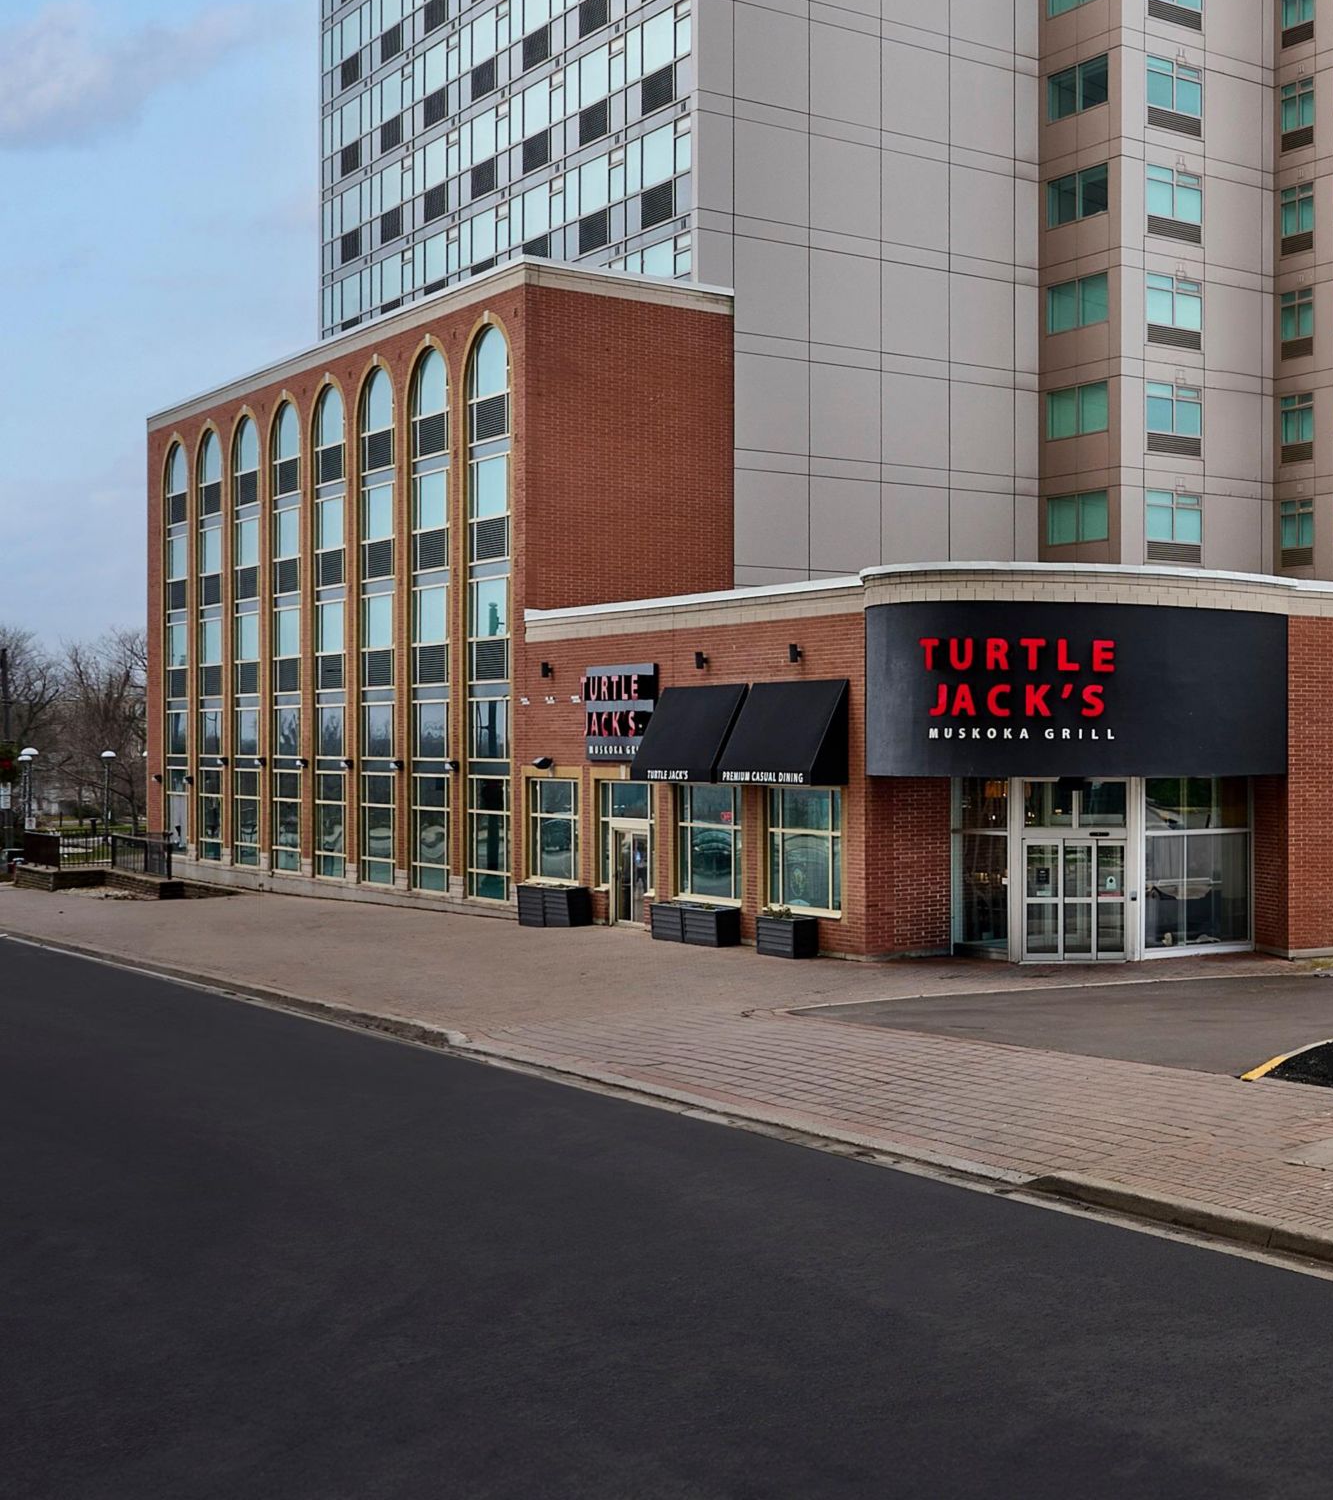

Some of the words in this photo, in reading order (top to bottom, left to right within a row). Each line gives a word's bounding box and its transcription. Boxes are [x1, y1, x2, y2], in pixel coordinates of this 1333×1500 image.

[919, 636, 1115, 672] TURTLE
[580, 674, 638, 700] TURTLE
[928, 683, 1105, 718] JACK'S
[929, 727, 1029, 739] MUSKOKA
[1044, 728, 1115, 739] GRILL
[588, 745, 623, 755] MUSKOKA
[647, 770, 667, 780] TURTLE
[668, 770, 689, 780] JACK'S
[722, 771, 750, 781] PREMIUM
[751, 772, 777, 782] CASUAL
[778, 772, 803, 783] DINING
